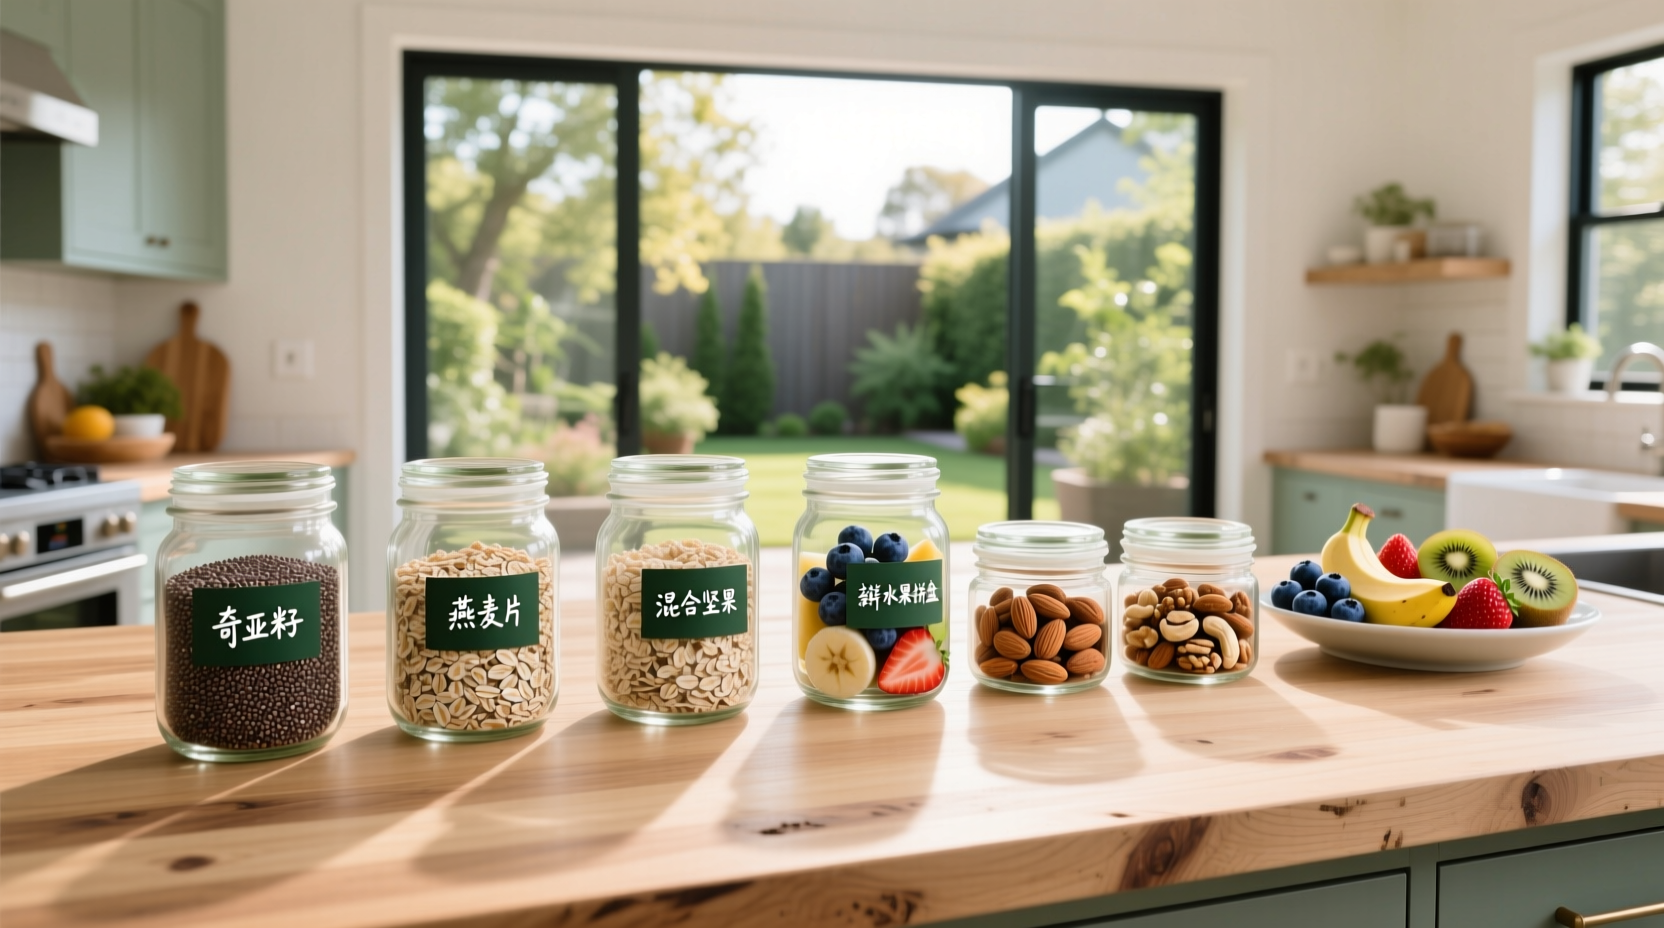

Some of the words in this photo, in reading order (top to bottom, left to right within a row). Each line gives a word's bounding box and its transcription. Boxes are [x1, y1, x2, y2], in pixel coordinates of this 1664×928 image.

[448, 594, 521, 631] 燕麦片
[654, 587, 738, 618] 混合坚果
[211, 605, 304, 649] 奇亚籽
